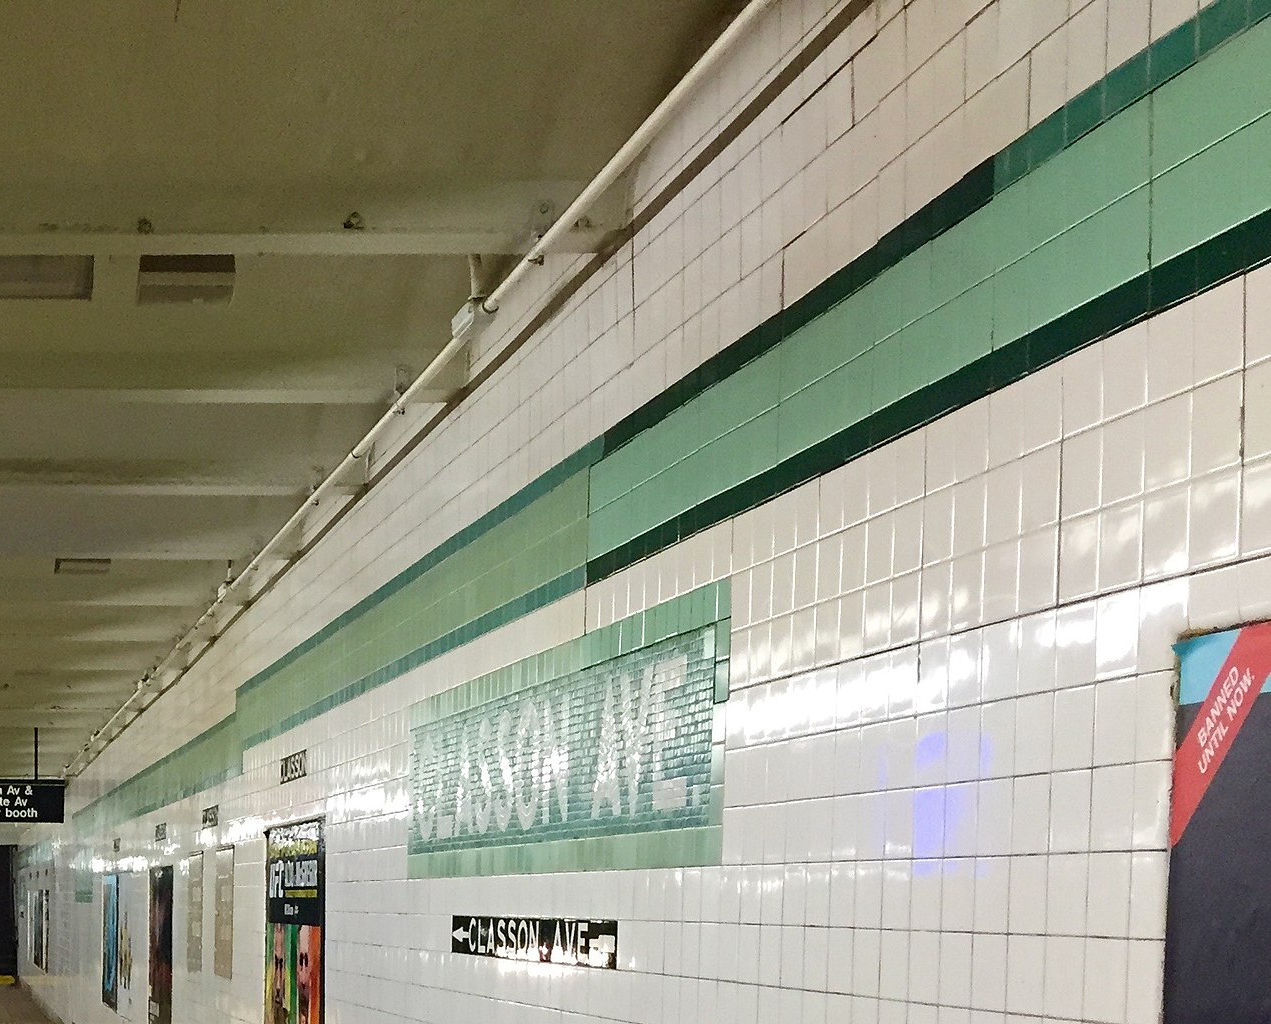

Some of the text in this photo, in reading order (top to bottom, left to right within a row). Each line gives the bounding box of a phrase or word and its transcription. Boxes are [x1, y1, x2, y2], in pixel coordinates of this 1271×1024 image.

[1197, 666, 1239, 748] BANNED
[1198, 667, 1255, 774] UNTIL NOW.
[415, 654, 687, 841] CLASSON AVE
[5, 808, 38, 817] booth
[6, 785, 20, 795] Av
[24, 785, 33, 795] &
[14, 796, 28, 806] Av
[468, 917, 590, 964] CLASSON AVE
